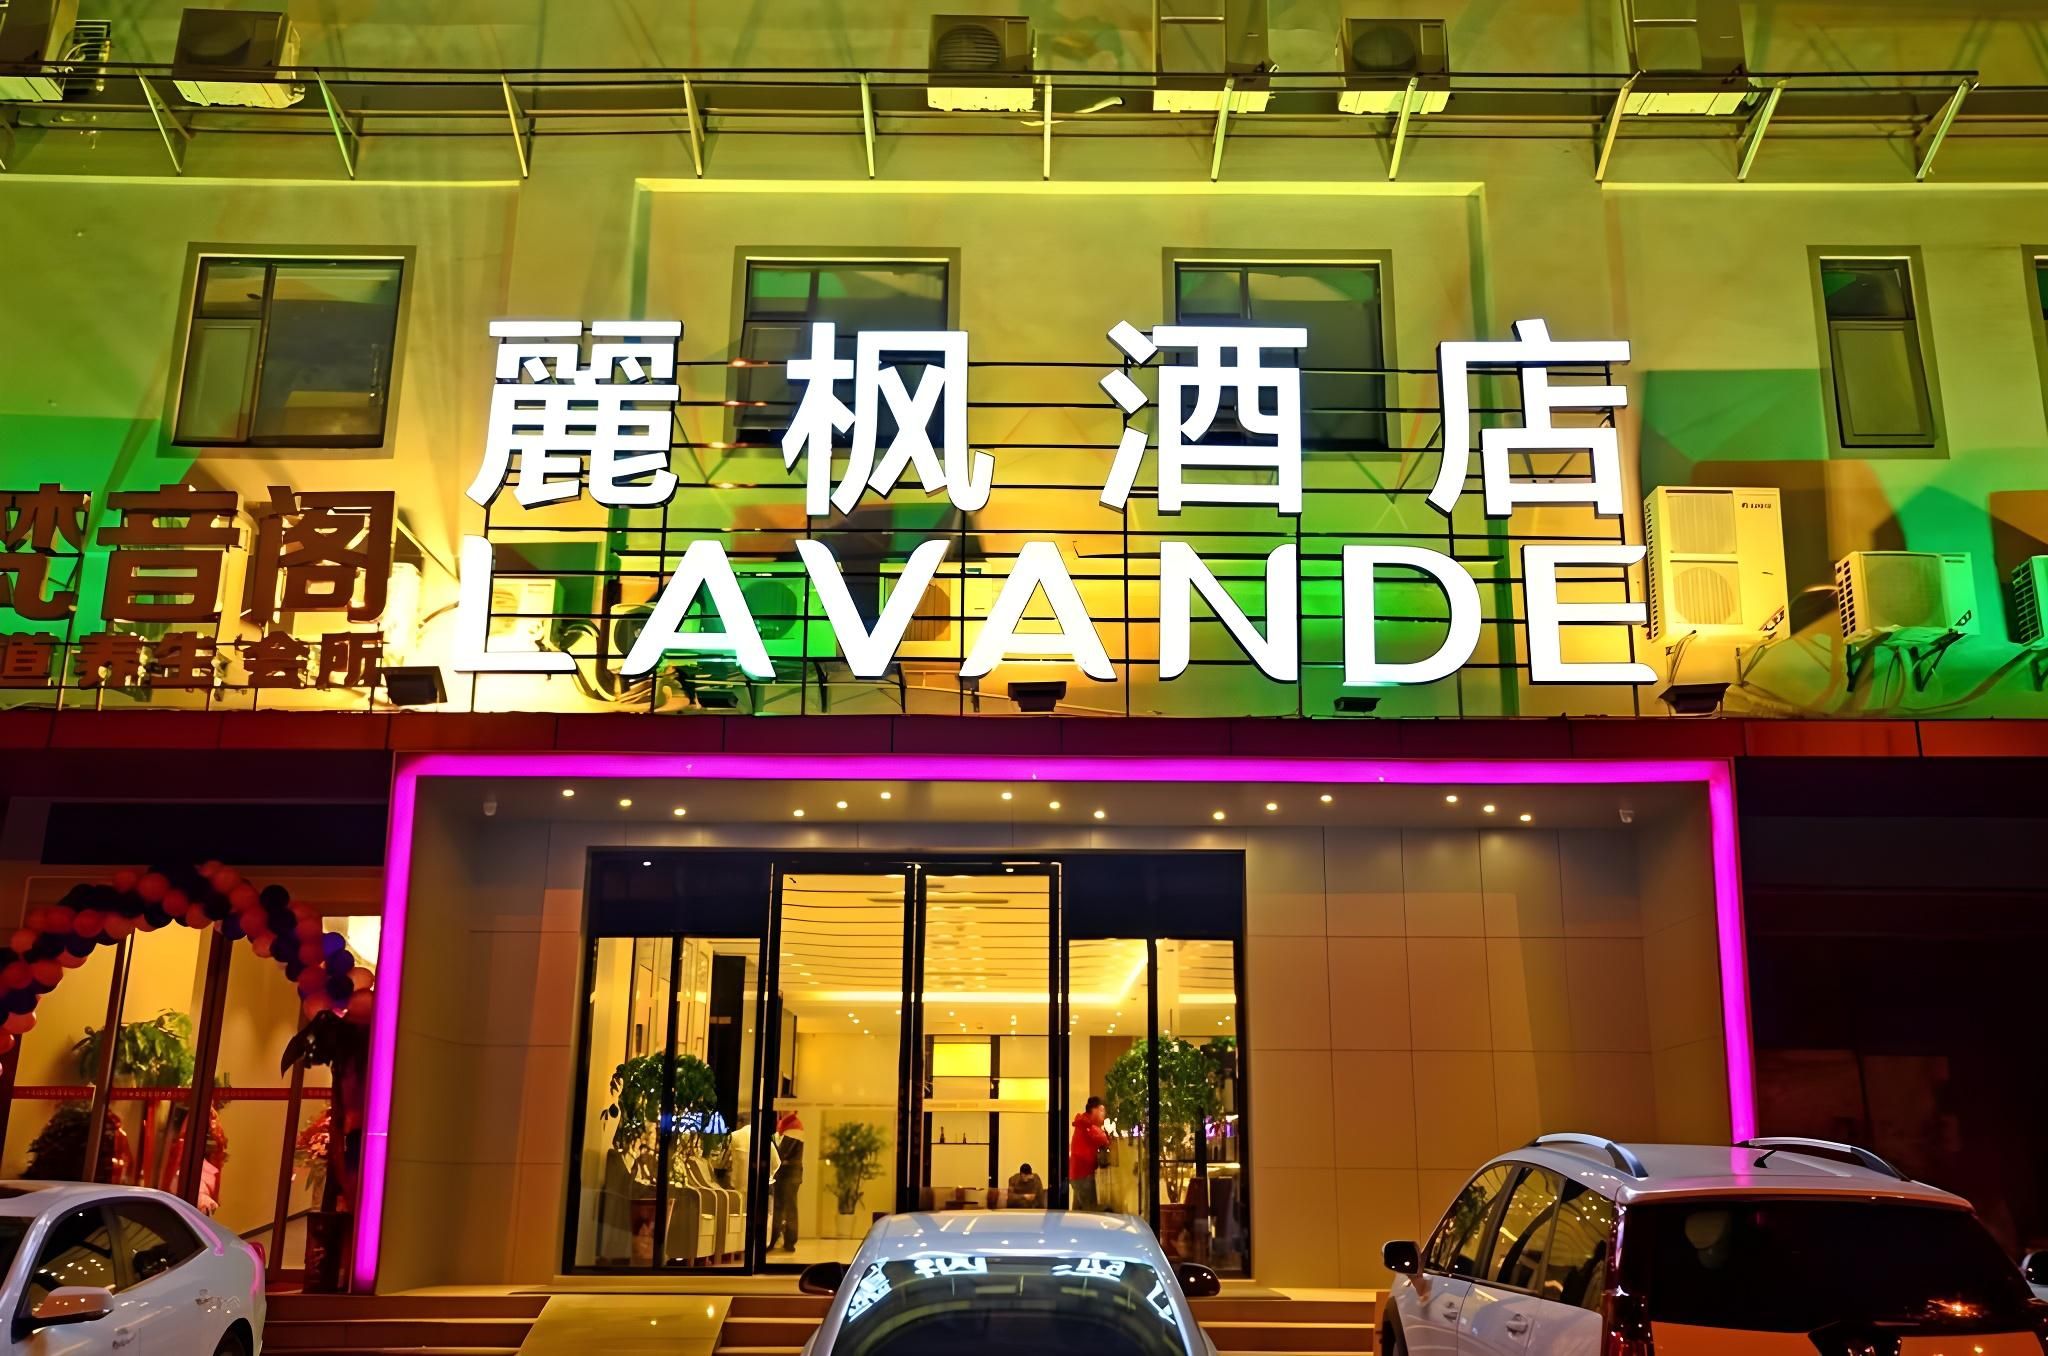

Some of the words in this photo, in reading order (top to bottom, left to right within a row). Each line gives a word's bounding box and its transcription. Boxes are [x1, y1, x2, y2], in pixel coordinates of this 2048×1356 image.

[464, 318, 1631, 517] 麗枫酒店
[453, 533, 1659, 686] LAVANDE
